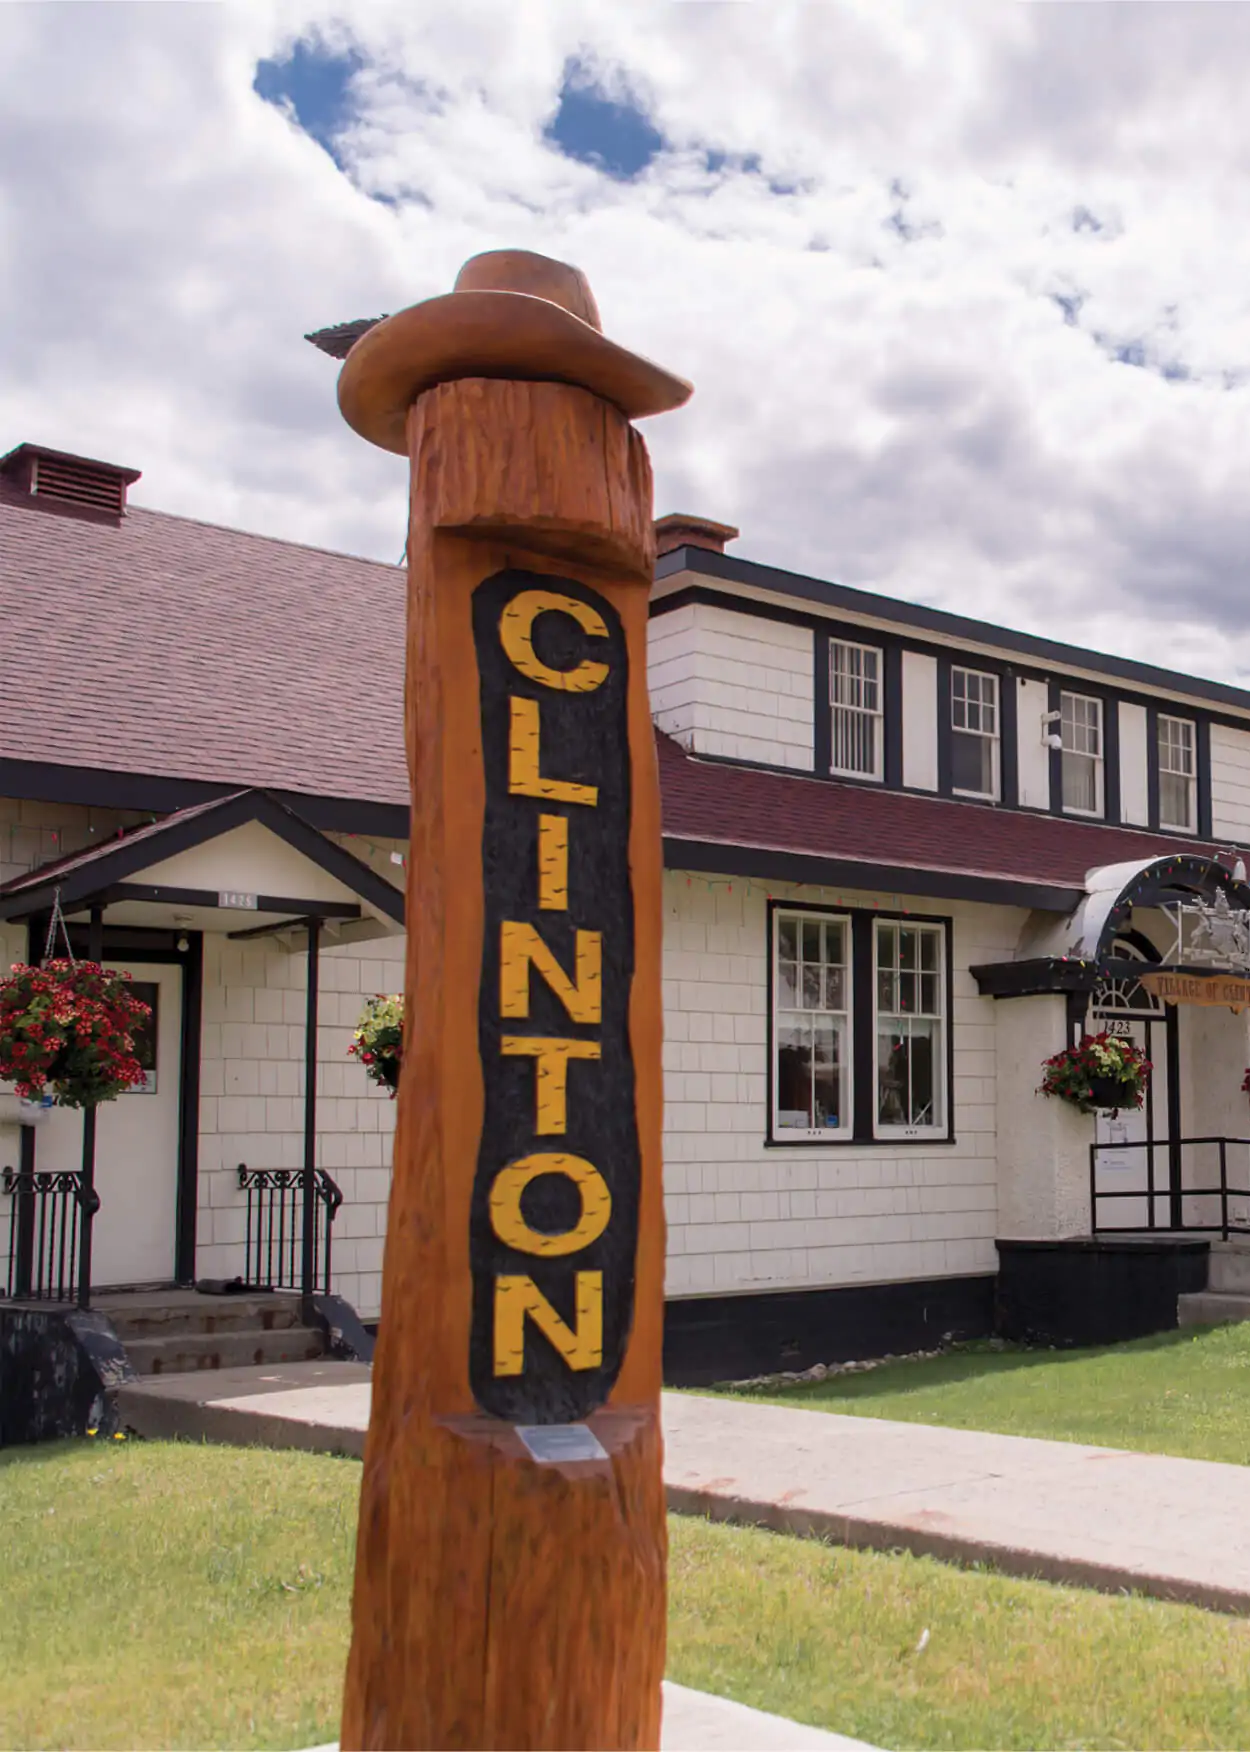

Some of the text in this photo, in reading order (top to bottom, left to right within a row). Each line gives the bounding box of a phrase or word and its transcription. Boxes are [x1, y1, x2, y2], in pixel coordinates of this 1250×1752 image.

[489, 589, 612, 1378] CLINTON
[1205, 981, 1218, 1001] OF
[1103, 1020, 1131, 1035] 1423
